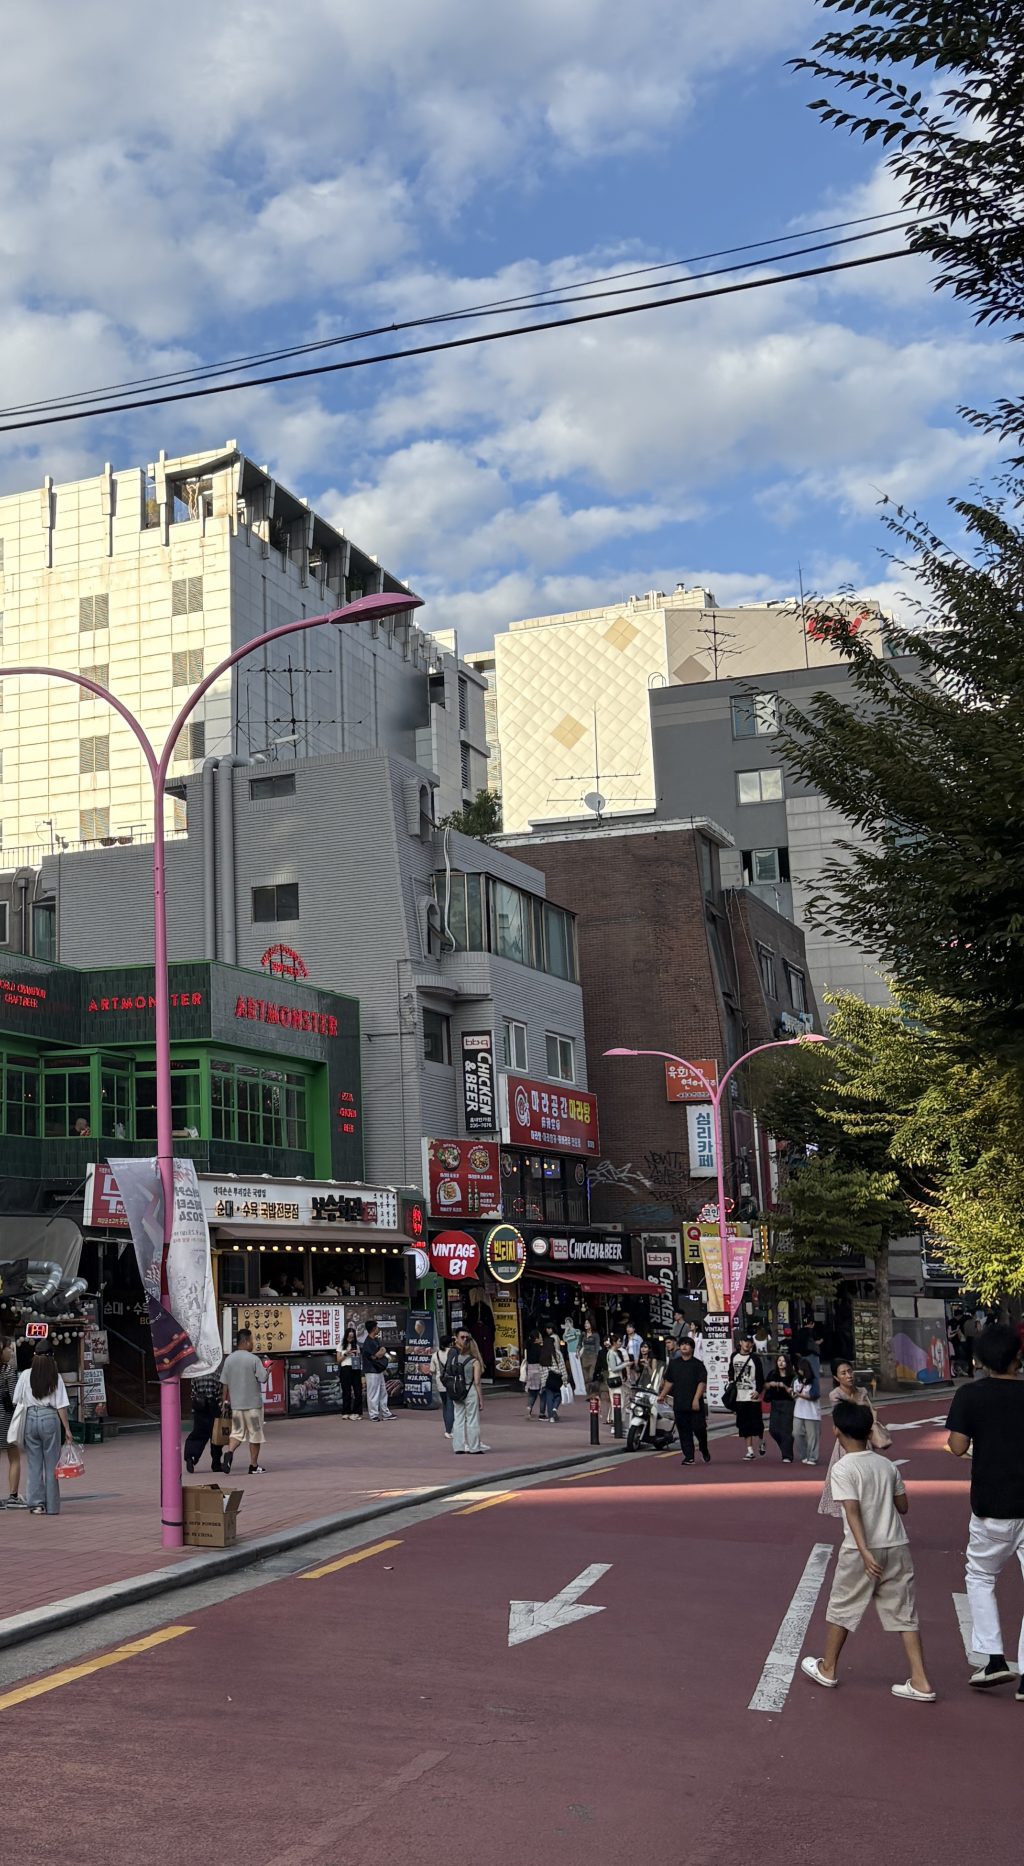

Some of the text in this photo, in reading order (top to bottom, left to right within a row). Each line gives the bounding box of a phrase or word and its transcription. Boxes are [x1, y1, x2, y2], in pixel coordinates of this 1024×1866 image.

[88, 993, 202, 1012] ARTMONTER
[234, 995, 338, 1037] ARTMONSTER
[465, 1038, 489, 1048] bbq
[668, 1066, 688, 1079] 육회
[464, 1060, 479, 1112] & BEER
[477, 1052, 492, 1116] CHICKEN
[681, 1078, 703, 1090] 연어
[530, 1090, 567, 1119] 마라공간
[696, 1112, 713, 1168] 심리카페
[217, 1200, 299, 1219] 순대 수육 국밥전문점
[704, 1208, 719, 1217] 코인
[431, 1243, 476, 1258] VINTAGE
[554, 1242, 567, 1255] bbq
[448, 1258, 468, 1276] B1
[648, 1255, 671, 1264] bbq
[659, 1268, 674, 1330] CHICKEN
[103, 1302, 124, 1315] 순대
[298, 1309, 330, 1326] 수육국밥
[298, 1329, 331, 1347] 순대국밥
